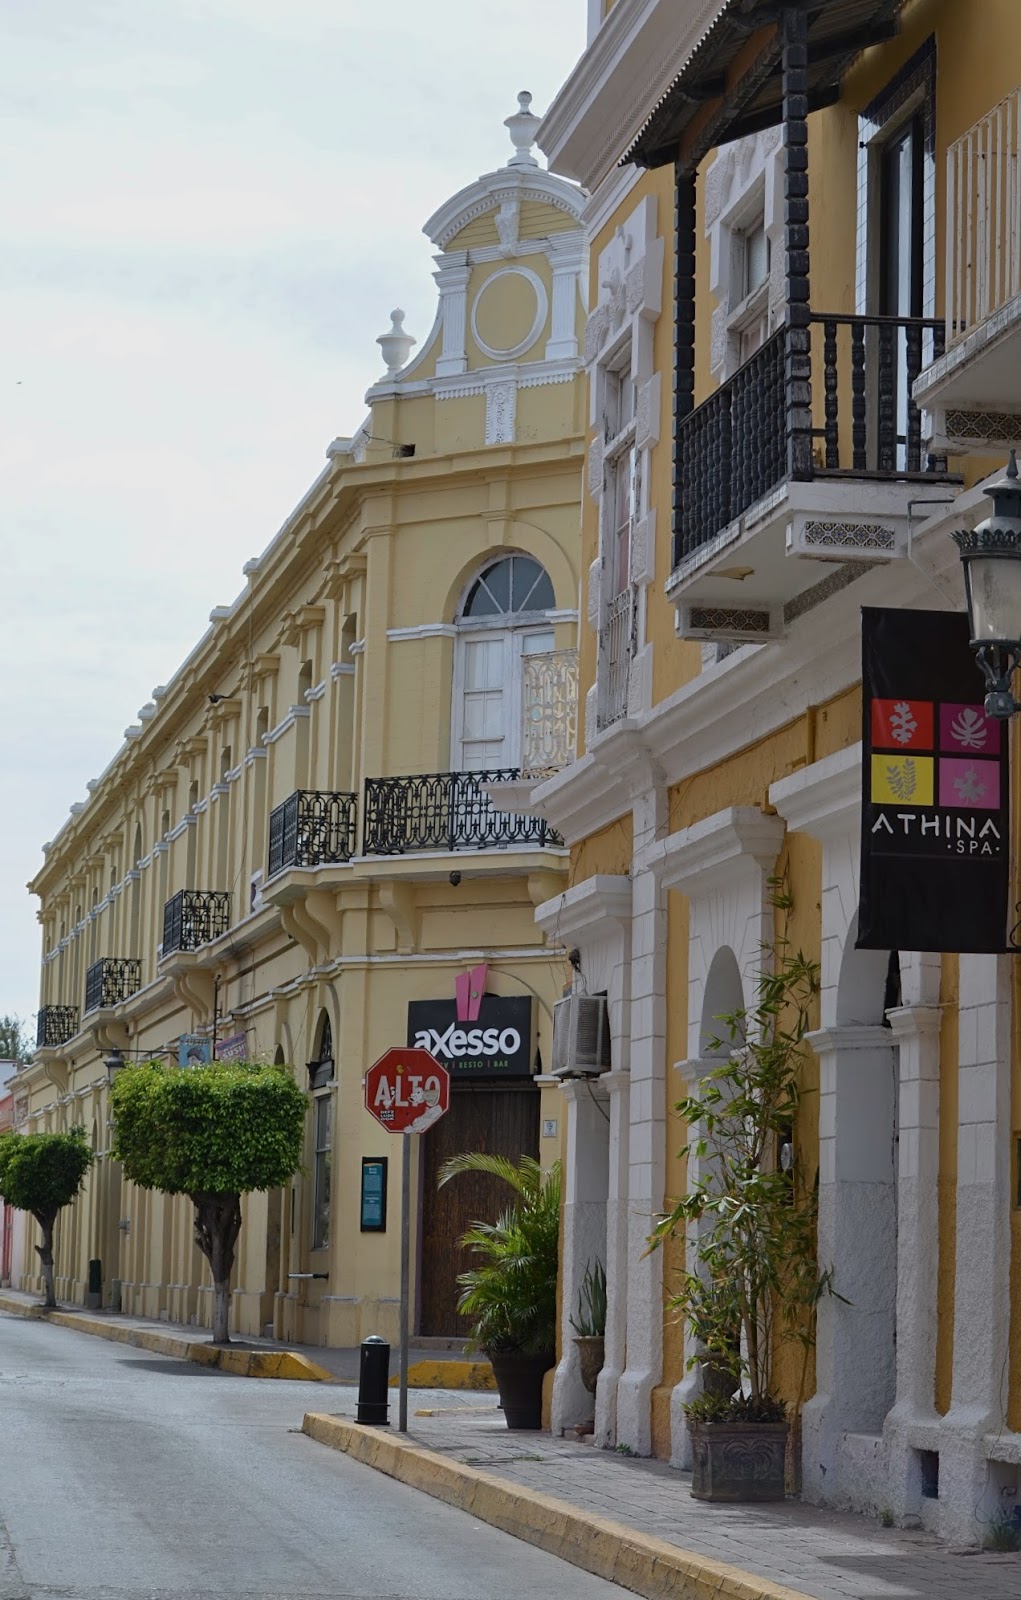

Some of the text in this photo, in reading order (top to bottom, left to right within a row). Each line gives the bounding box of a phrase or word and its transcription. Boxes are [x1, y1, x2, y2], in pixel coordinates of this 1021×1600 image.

[871, 813, 1001, 839] ATHINA
[414, 1021, 521, 1058] axesso
[458, 1060, 484, 1069] RESTO
[493, 1060, 509, 1068] BAR
[373, 1075, 441, 1107] ALTO
